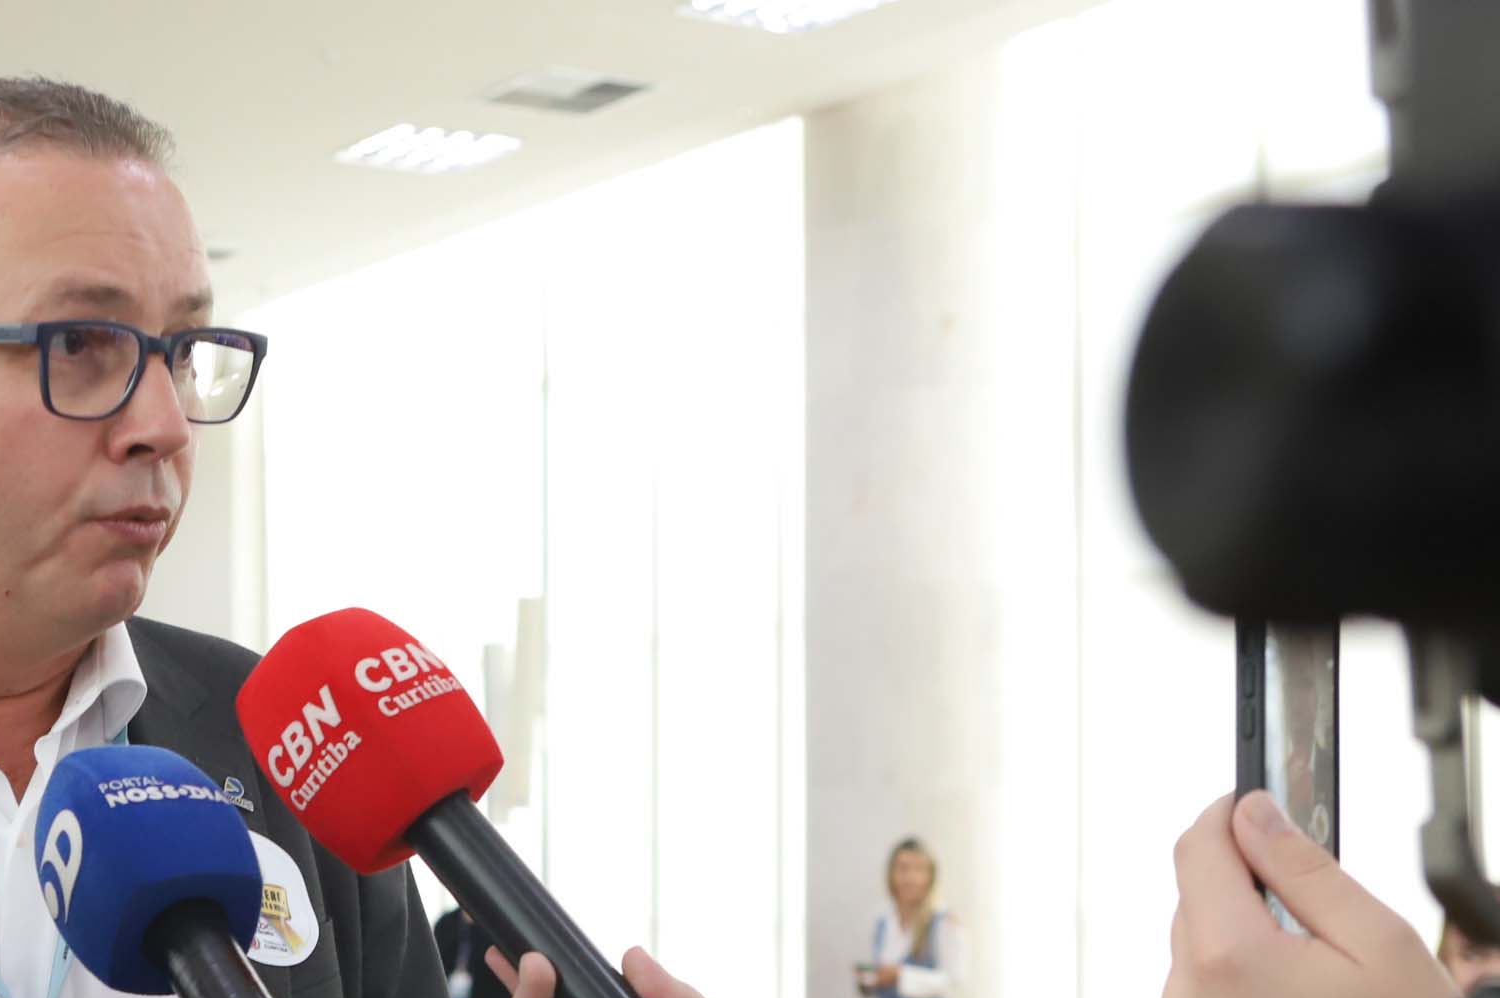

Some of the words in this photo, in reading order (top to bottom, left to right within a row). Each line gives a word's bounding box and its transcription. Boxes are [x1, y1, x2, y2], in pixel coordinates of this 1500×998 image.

[355, 643, 444, 693] CBN
[378, 675, 466, 717] Curitiba
[268, 684, 341, 787] CBN
[98, 776, 164, 793] PORTAL
[290, 731, 362, 811] Curitiba
